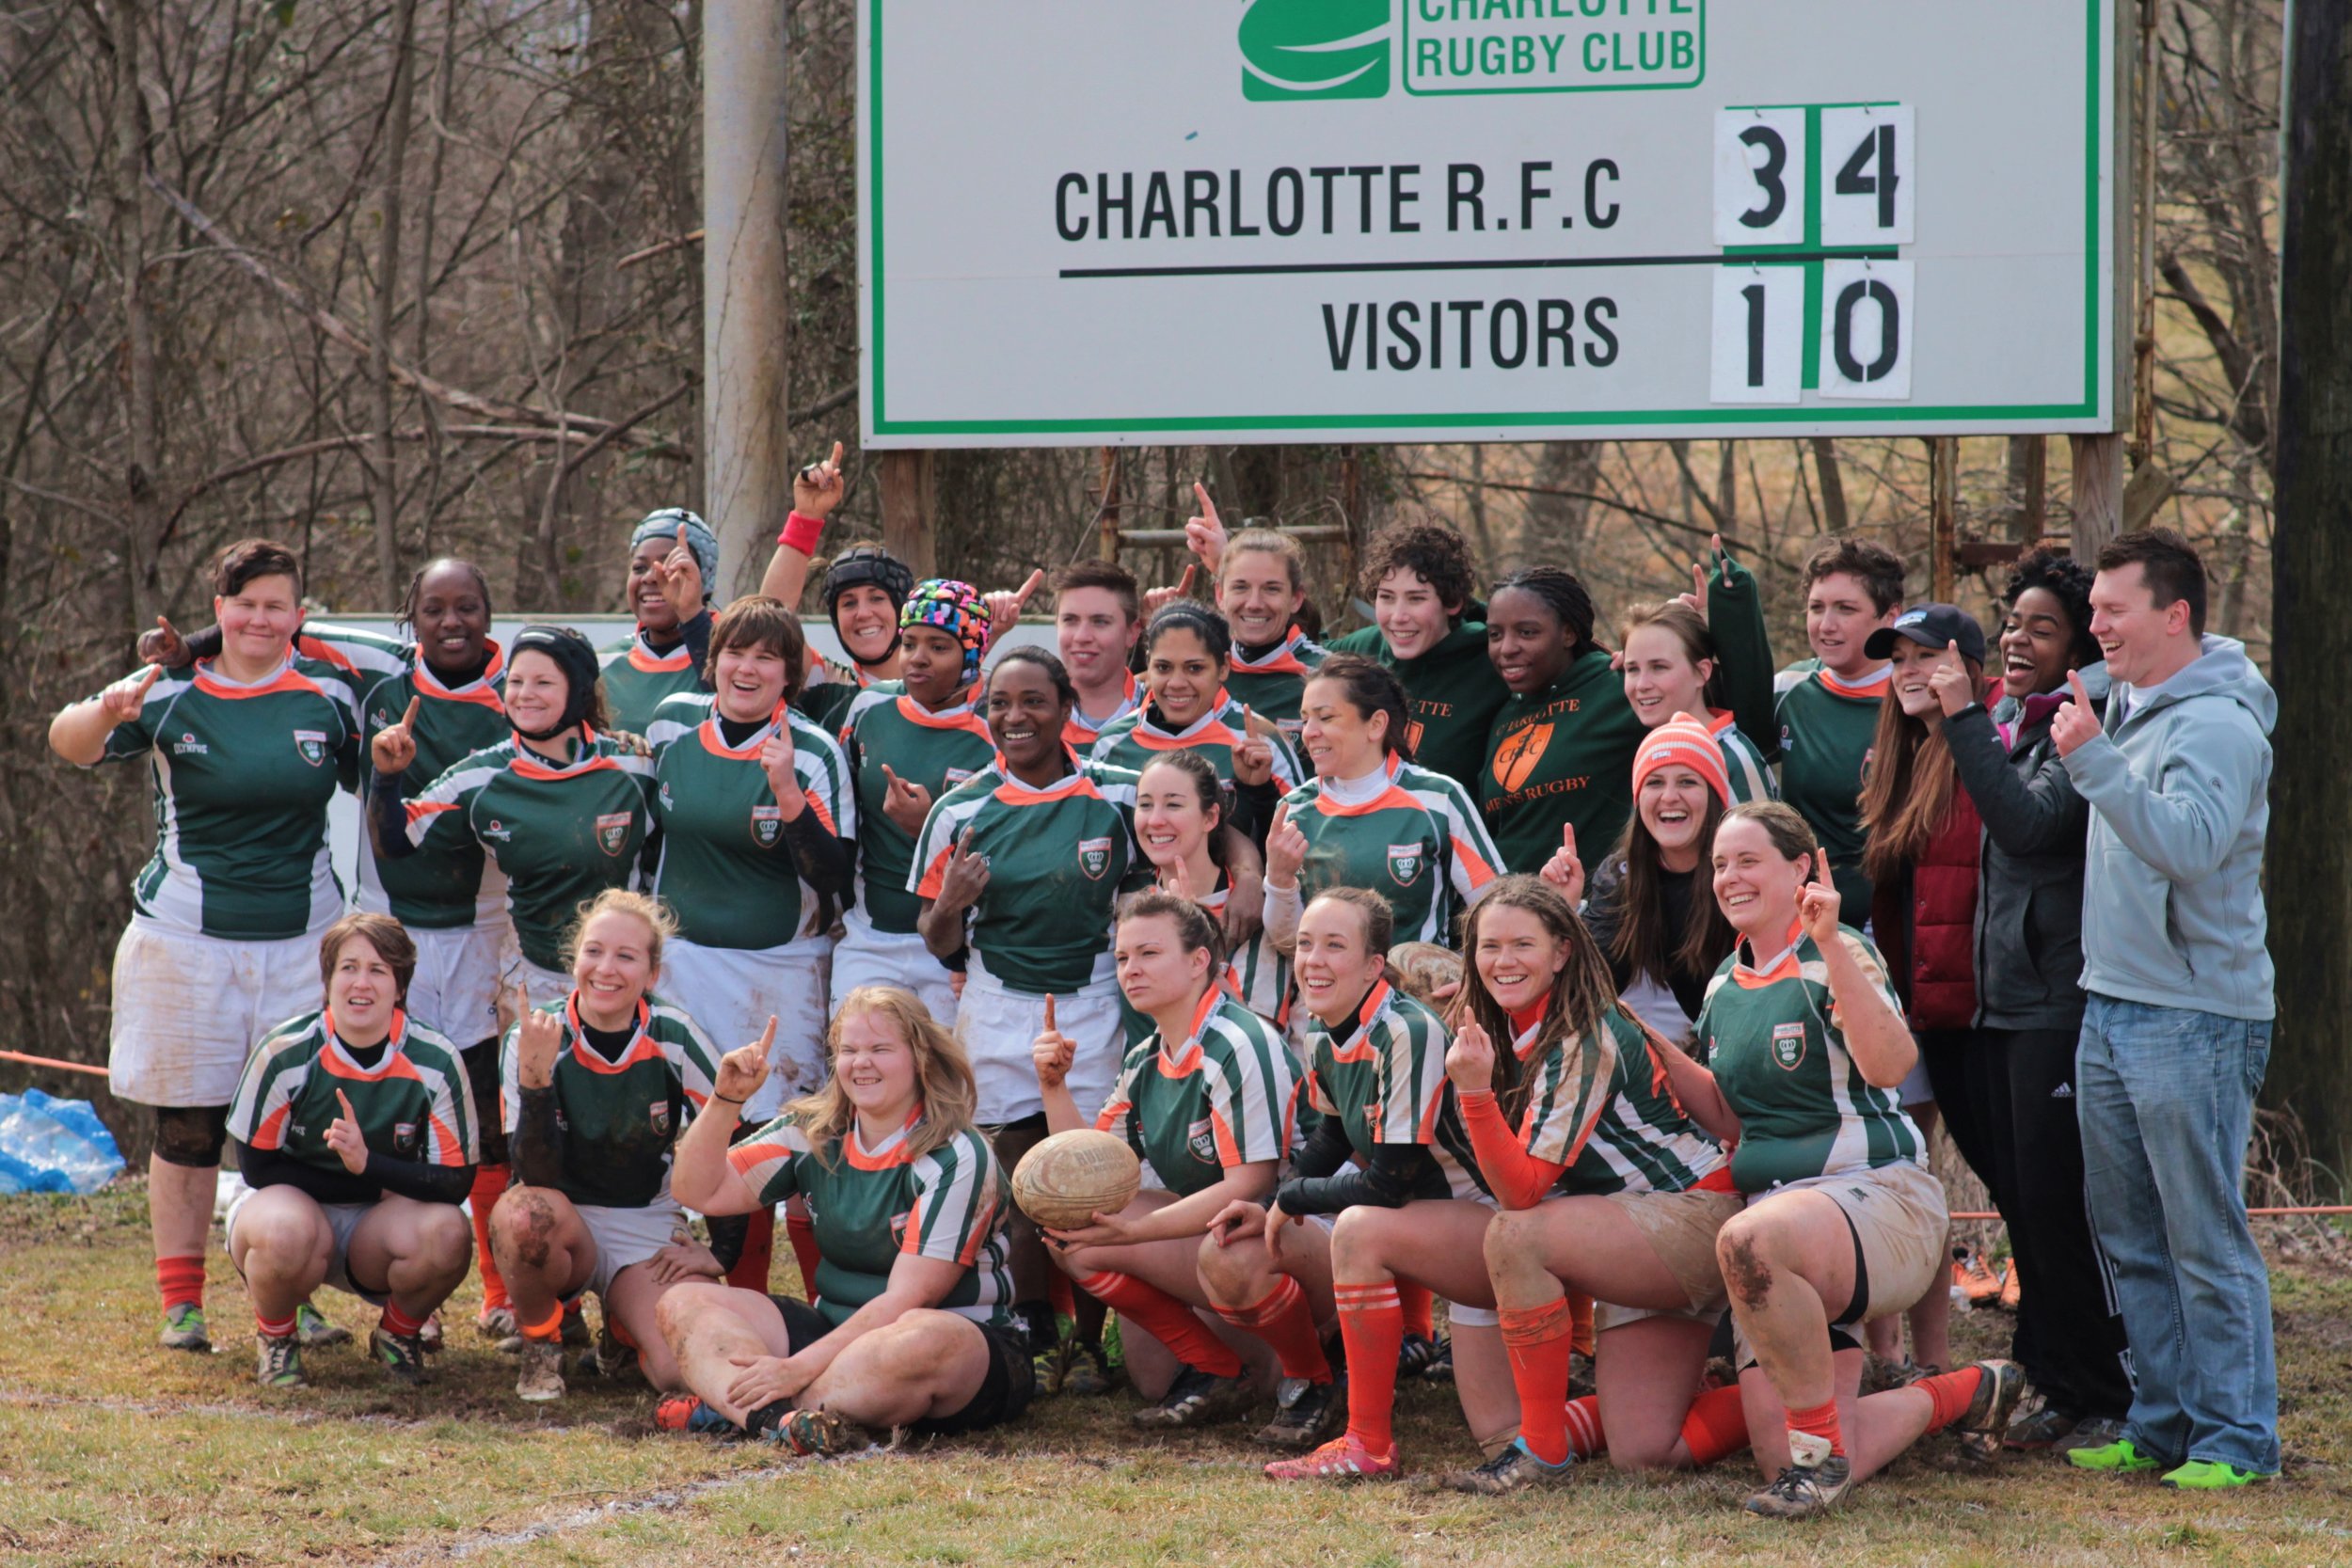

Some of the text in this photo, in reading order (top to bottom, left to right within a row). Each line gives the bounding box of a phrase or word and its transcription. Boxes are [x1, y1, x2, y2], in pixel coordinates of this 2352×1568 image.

[1416, 30, 1695, 77] RUGBY CLUB
[1056, 165, 1422, 242] CHARLOTTE
[1447, 158, 1620, 231] R.F.C
[1322, 296, 1619, 372] VISITORS
[1525, 776, 1591, 800] RUGBY
